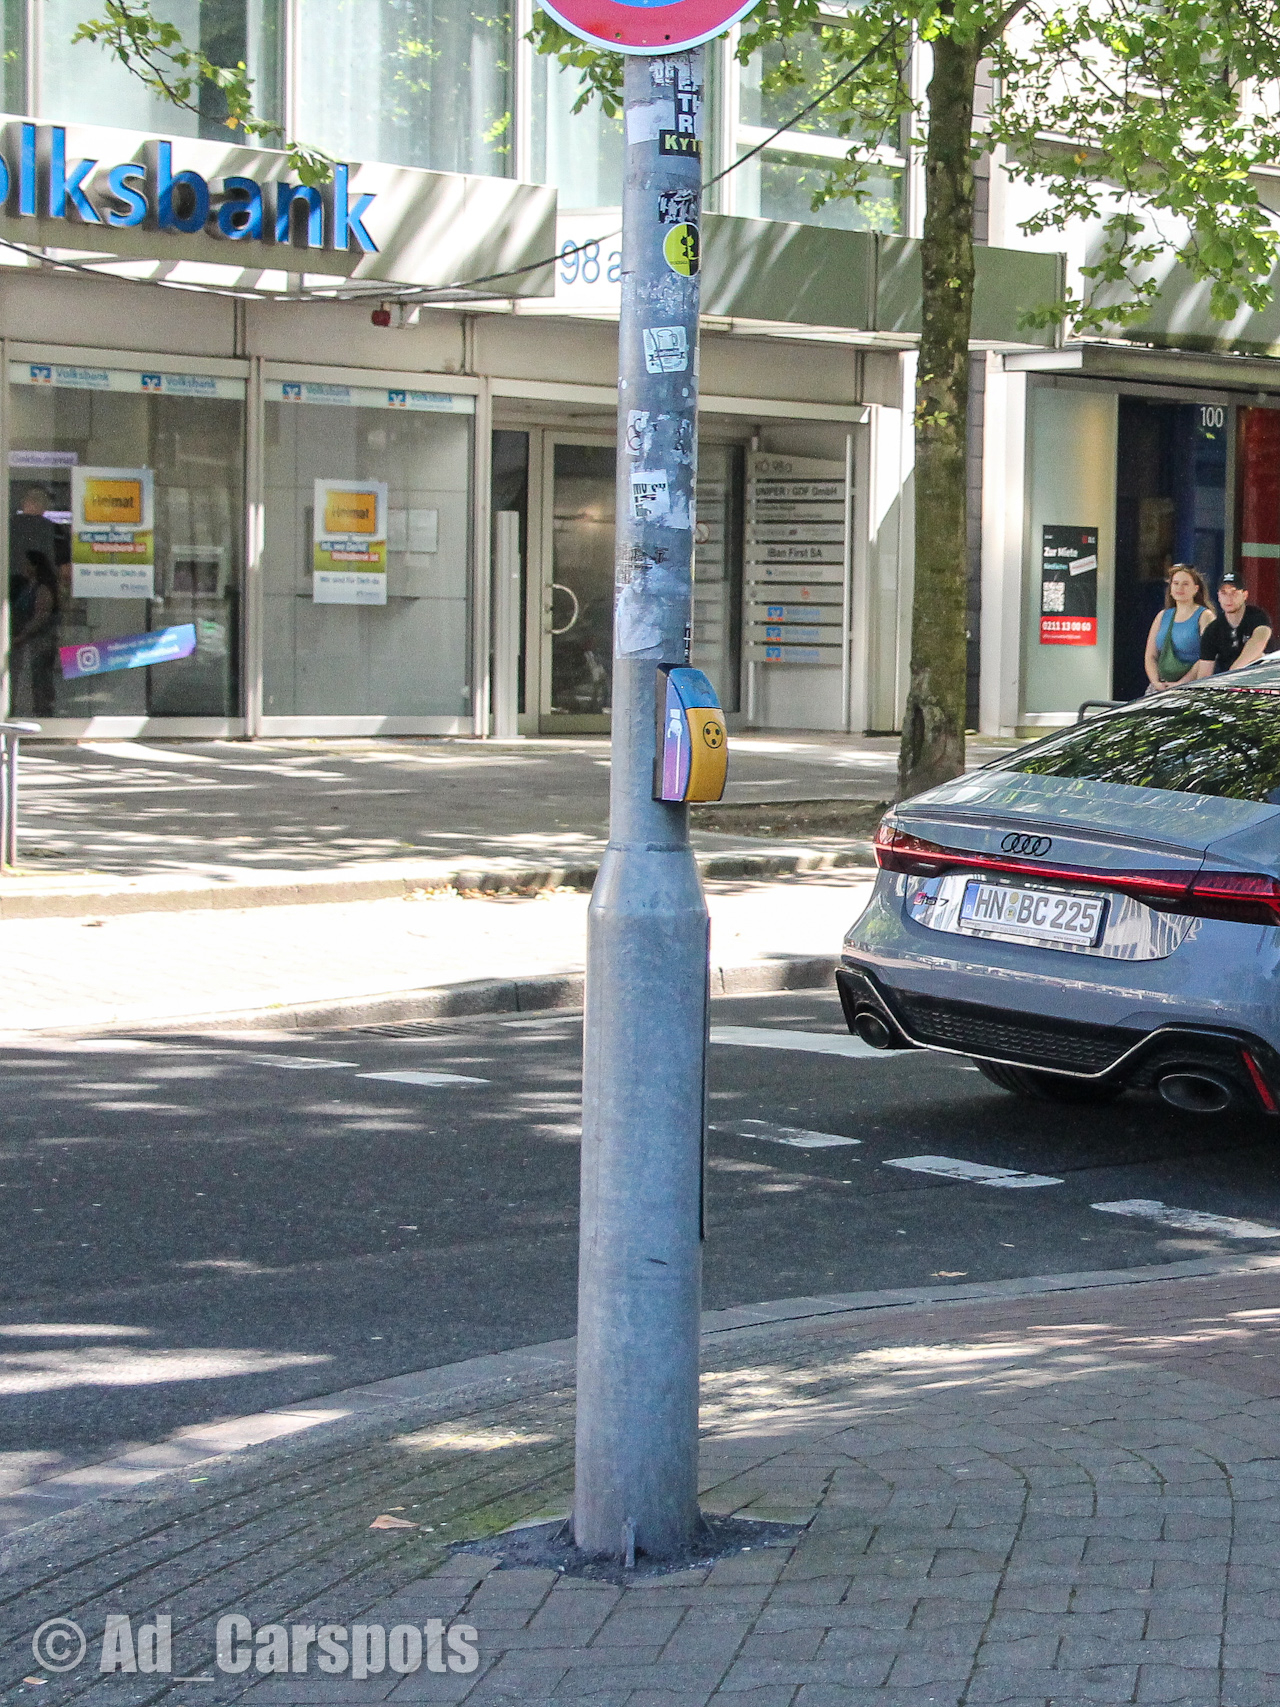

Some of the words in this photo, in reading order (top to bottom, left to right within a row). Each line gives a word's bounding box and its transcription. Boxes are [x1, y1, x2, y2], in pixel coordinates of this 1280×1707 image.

[0, 122, 380, 253] lksbank
[56, 366, 109, 382] Volksbank
[1200, 406, 1224, 428] 100
[93, 495, 134, 508] Heimat
[1044, 546, 1057, 557] Zur
[1058, 546, 1078, 558] Miete
[1042, 621, 1061, 631] 0211
[1061, 621, 1071, 631] 13
[974, 888, 1007, 920] HN
[1016, 894, 1049, 926] BC
[1049, 899, 1098, 933] 225
